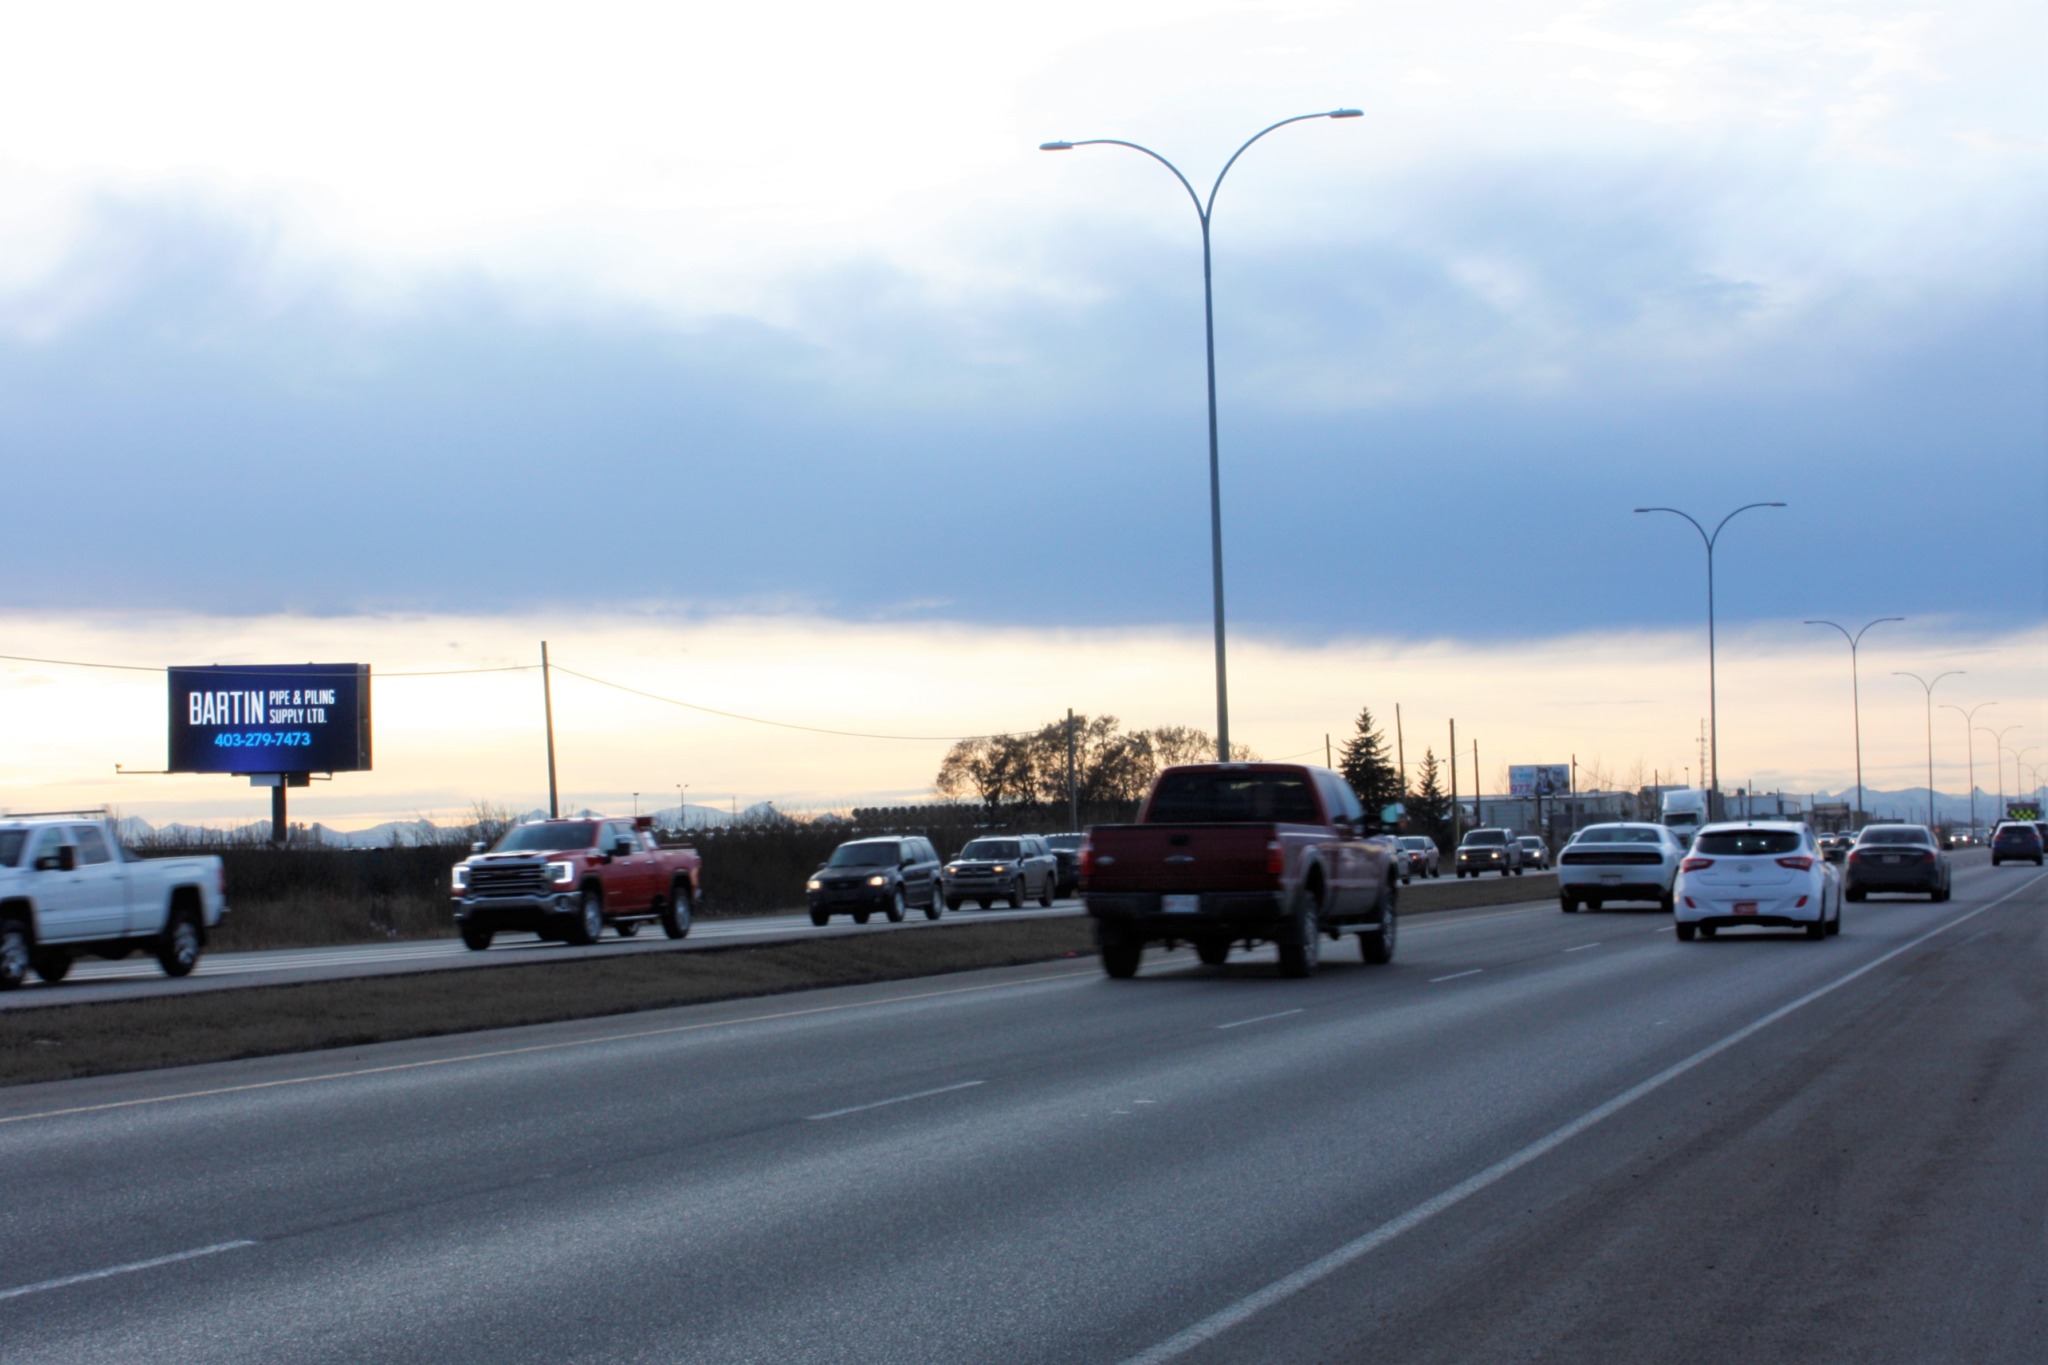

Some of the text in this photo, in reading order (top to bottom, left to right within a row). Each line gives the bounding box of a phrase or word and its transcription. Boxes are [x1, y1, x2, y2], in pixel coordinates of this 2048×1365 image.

[269, 689, 335, 705] PIPE & PILING
[189, 691, 264, 725] BARTIN
[269, 708, 327, 724] SUPPLY LTD.
[214, 732, 311, 747] 403-279-7473
